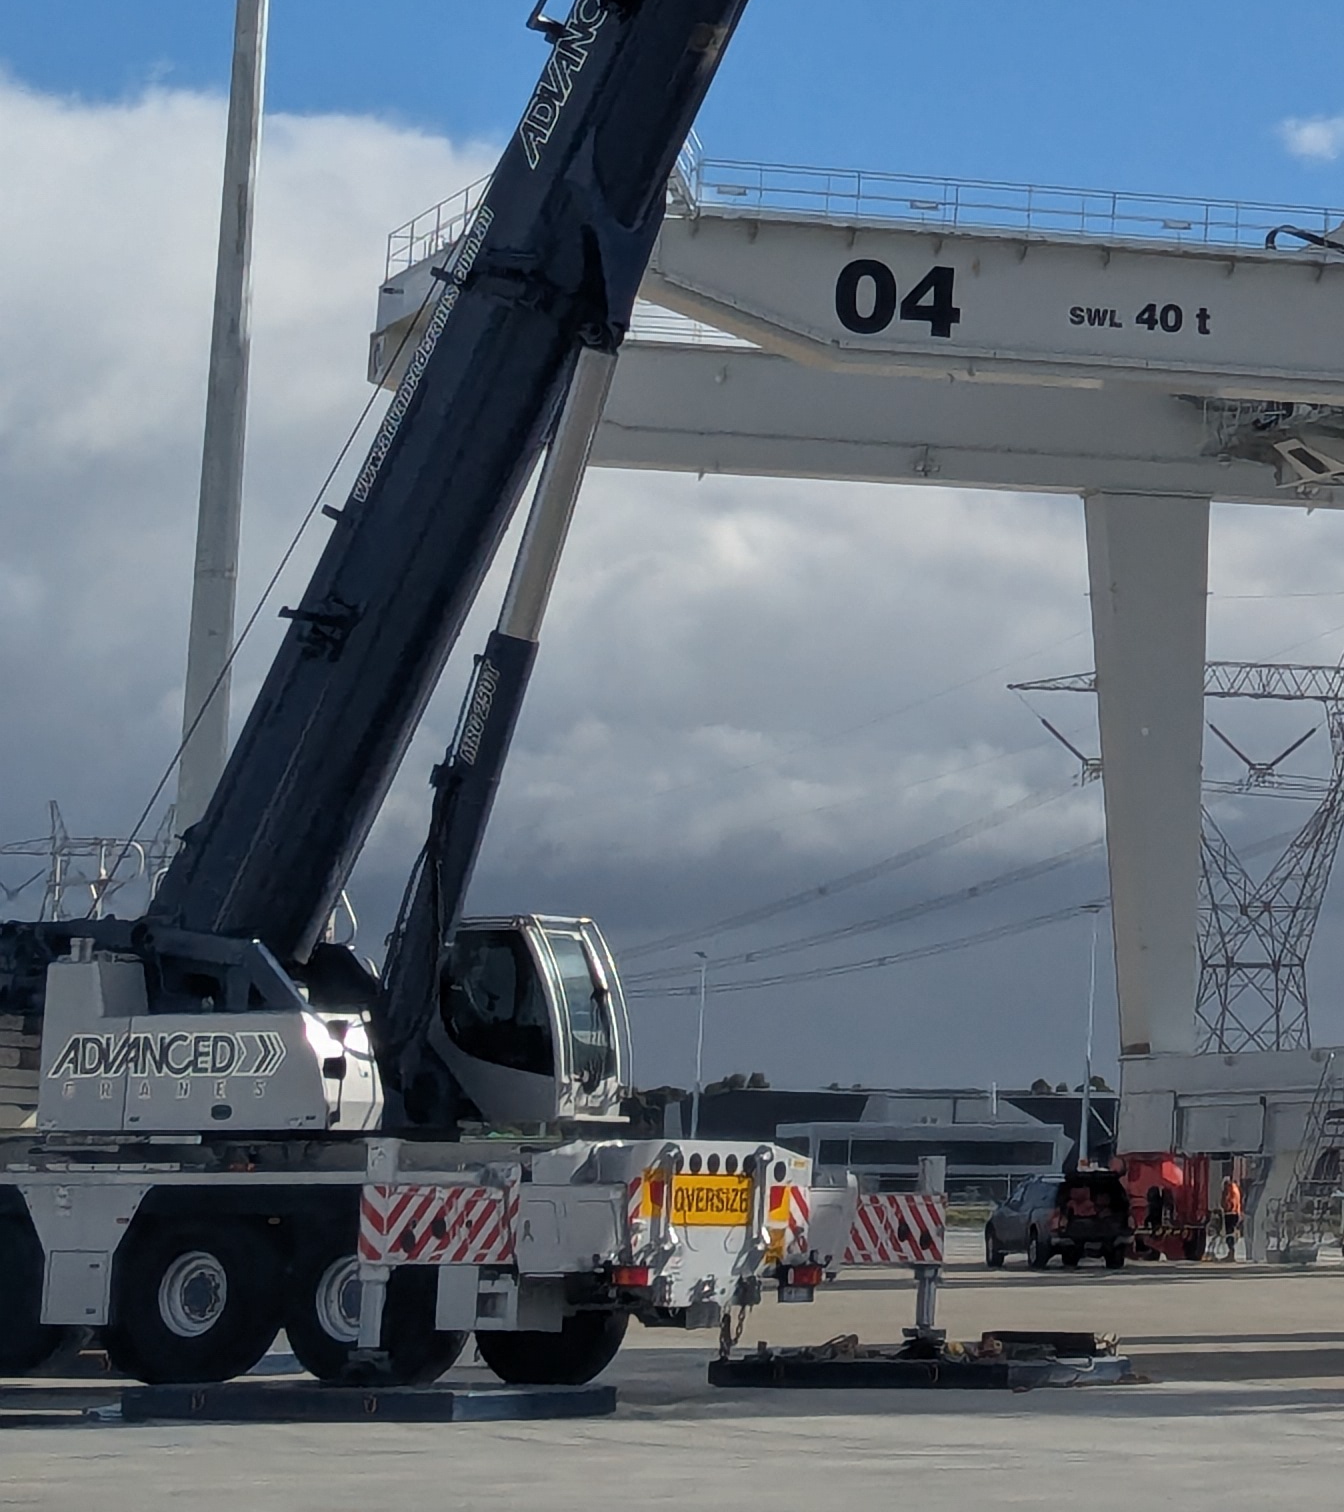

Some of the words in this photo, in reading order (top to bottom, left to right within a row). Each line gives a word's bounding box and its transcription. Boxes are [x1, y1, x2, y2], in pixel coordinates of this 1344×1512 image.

[835, 259, 961, 338] 04
[1069, 306, 1123, 329] SWL
[1135, 303, 1183, 333] 40
[1195, 307, 1211, 336] t
[48, 1033, 240, 1078] ADVANCED
[673, 1187, 748, 1214] OVERSIZE
